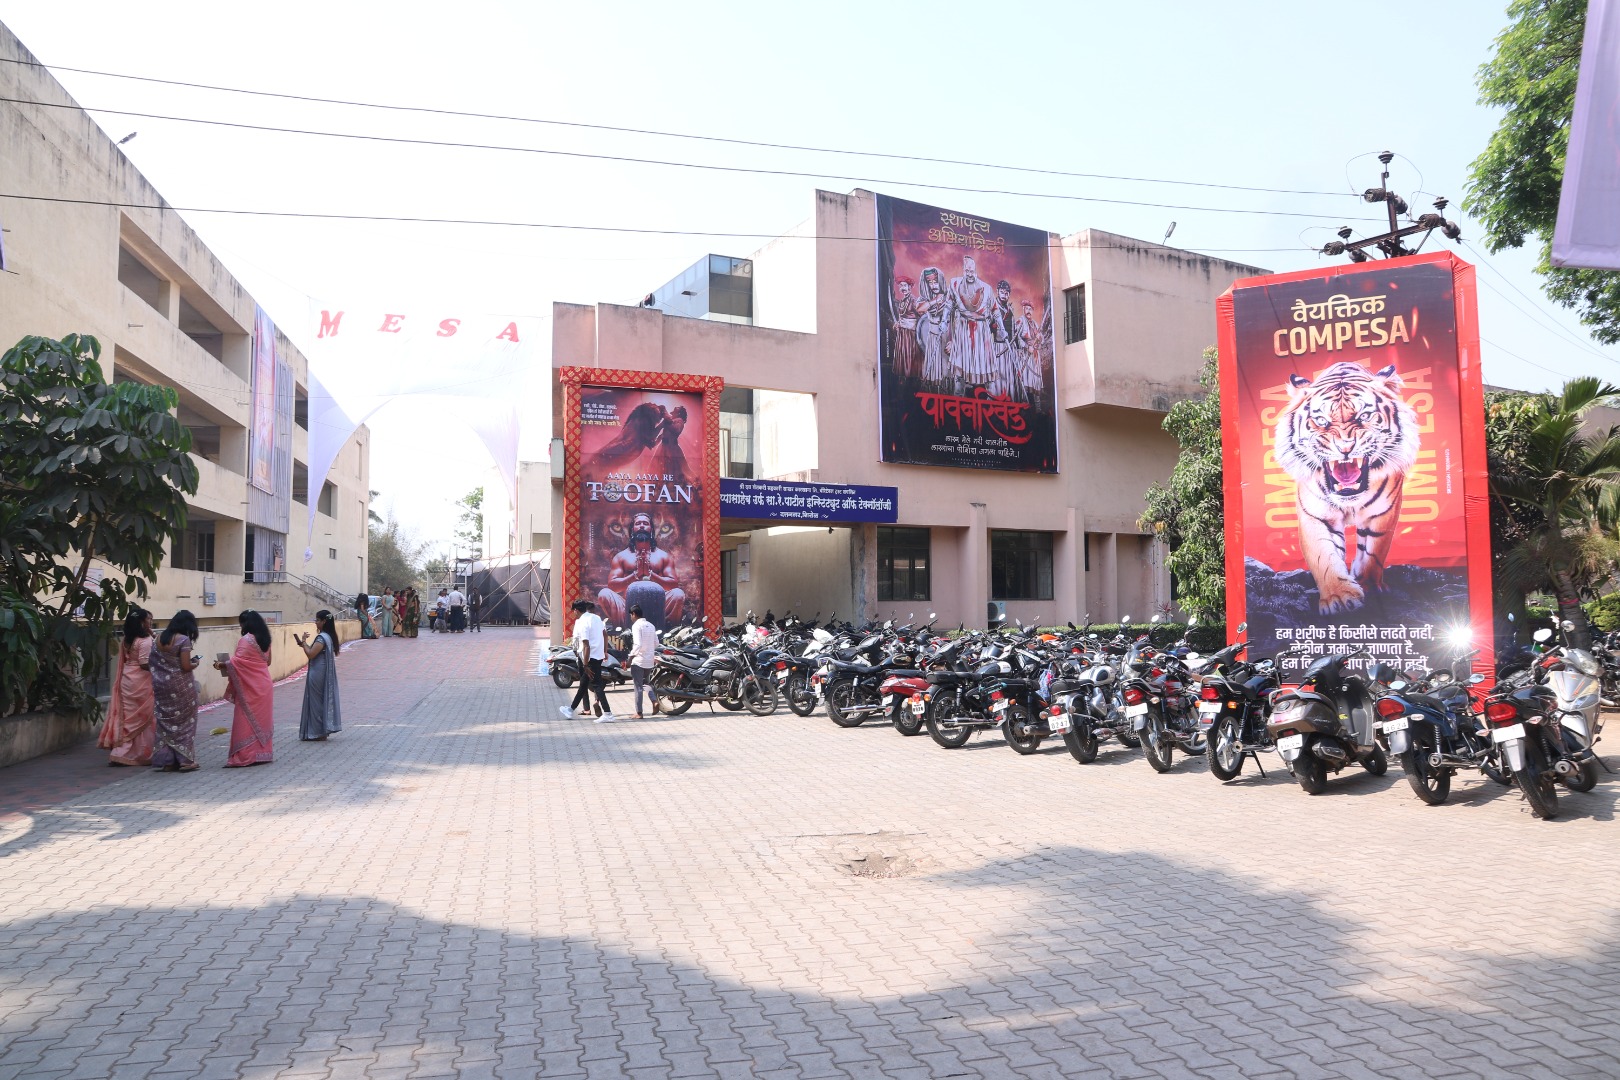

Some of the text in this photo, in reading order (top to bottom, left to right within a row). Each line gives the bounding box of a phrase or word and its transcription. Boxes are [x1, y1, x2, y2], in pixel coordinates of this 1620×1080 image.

[940, 212, 990, 233] स्थापत्य
[1291, 294, 1386, 323] वैयक्तिक
[1273, 315, 1410, 357] COMPESA
[607, 472, 674, 481] AAYA AAYA RE
[586, 481, 693, 504] TOOFAN
[1275, 627, 1292, 640] हम
[1295, 624, 1326, 640] शरीफ
[1328, 624, 1337, 640] है
[1338, 623, 1378, 640] किसीसे
[1380, 624, 1407, 640] लढते
[1365, 642, 1402, 655] जाणता
